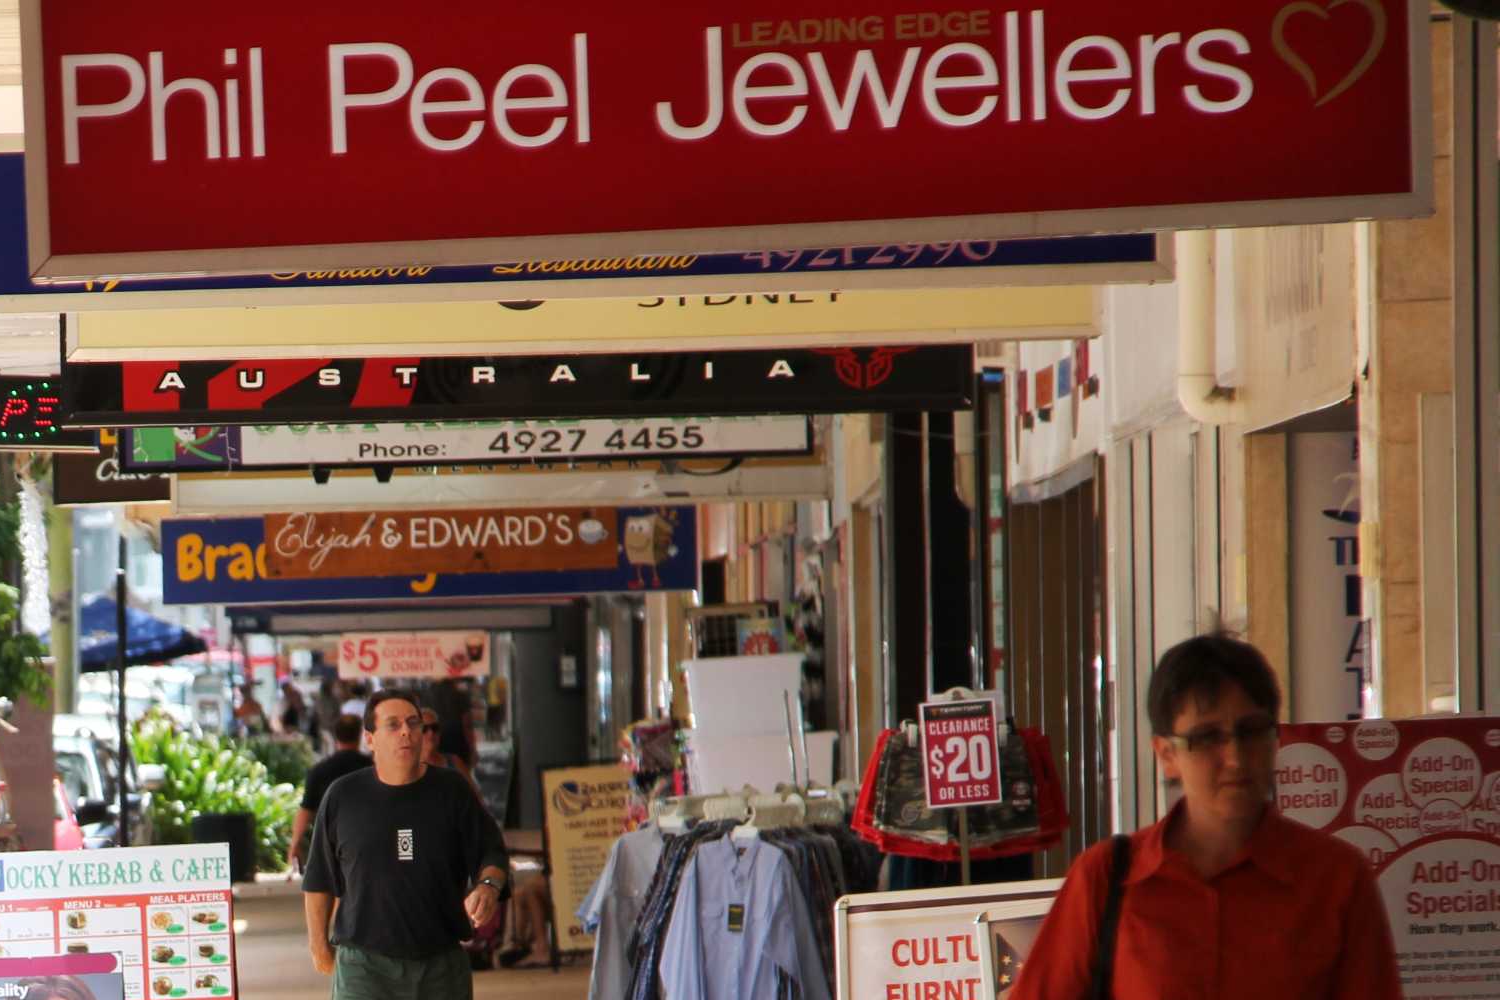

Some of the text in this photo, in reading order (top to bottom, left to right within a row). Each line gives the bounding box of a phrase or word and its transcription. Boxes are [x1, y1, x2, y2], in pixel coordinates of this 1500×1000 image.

[731, 10, 993, 48] LEADING EDGE
[61, 9, 1255, 165] Phil Peel Jewellers
[158, 358, 795, 391] AUSTRALIA
[358, 441, 447, 459] Phone:
[488, 428, 588, 454] 4927
[603, 425, 705, 451] 4455
[274, 512, 575, 570] Elijah & EDWARD'S
[342, 638, 380, 673] $5
[928, 717, 991, 736] CLEARANCE
[930, 734, 992, 783] $20
[1410, 755, 1475, 773] Add-On
[939, 784, 990, 800] OR LESS
[1279, 789, 1339, 811] pecial
[1410, 778, 1474, 797] Special
[68, 859, 143, 887] KEBAB
[149, 859, 164, 883] &
[171, 856, 229, 882] CAFE
[1411, 858, 1500, 884] Add-On
[64, 900, 93, 910] MENU
[149, 894, 176, 905] MEAL
[178, 892, 226, 903] PLATTERS
[1409, 924, 1435, 935] How
[1439, 922, 1463, 935] they
